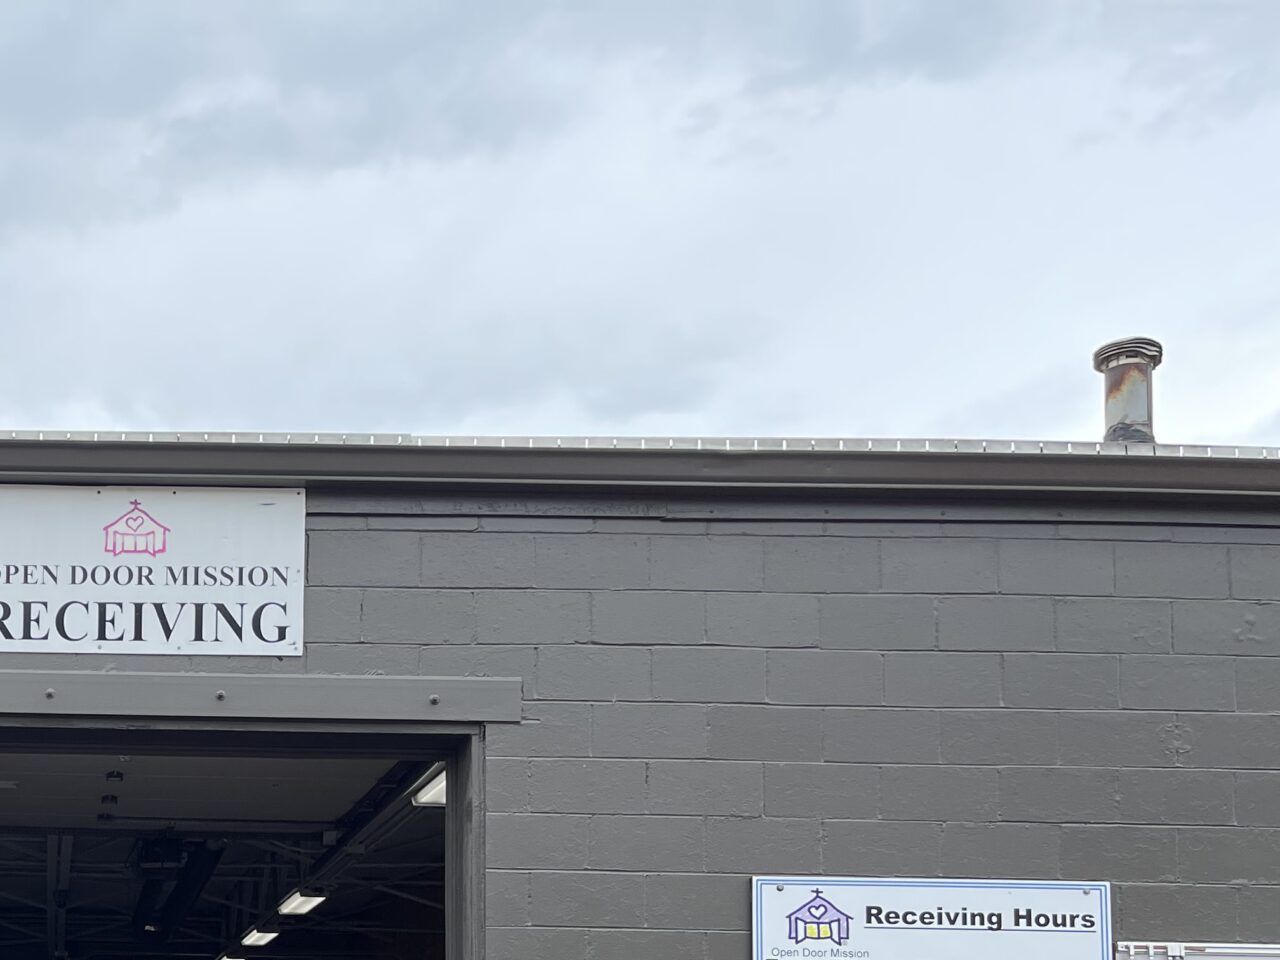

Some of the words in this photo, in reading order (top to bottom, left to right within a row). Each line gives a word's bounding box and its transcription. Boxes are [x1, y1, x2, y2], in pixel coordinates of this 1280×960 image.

[70, 565, 156, 586] DOOR
[164, 566, 290, 588] MISSION
[865, 906, 1003, 931] Receiving
[1013, 908, 1096, 929] Hours
[771, 948, 799, 958] Open
[803, 948, 828, 958] Door
[830, 948, 870, 959] Mission
